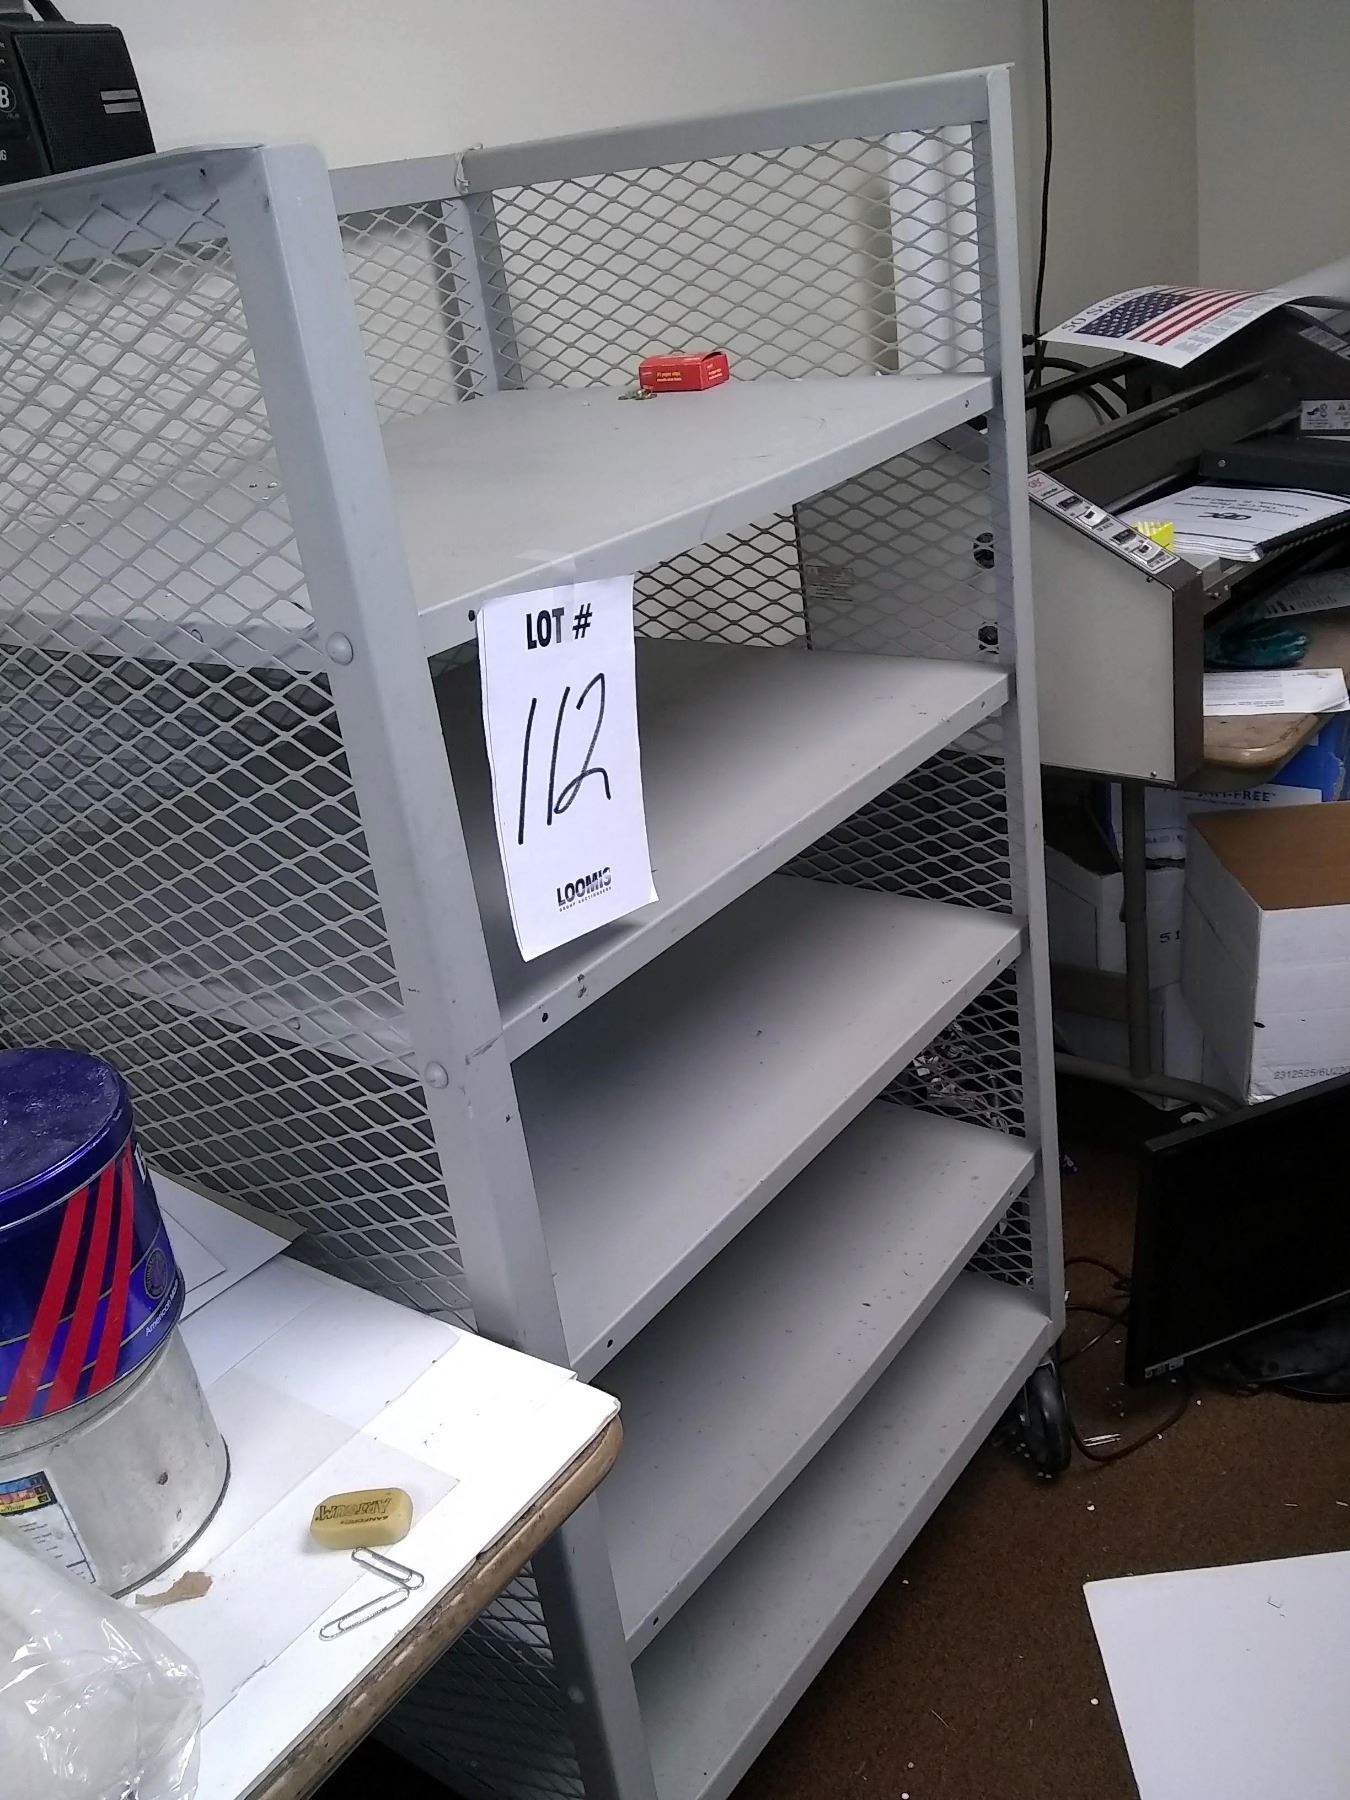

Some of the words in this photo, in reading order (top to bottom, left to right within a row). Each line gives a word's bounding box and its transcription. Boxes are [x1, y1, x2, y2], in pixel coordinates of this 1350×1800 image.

[526, 607, 564, 650] LOT
[572, 602, 593, 640] #
[518, 672, 612, 846] 112
[556, 866, 612, 907] LOOMIS
